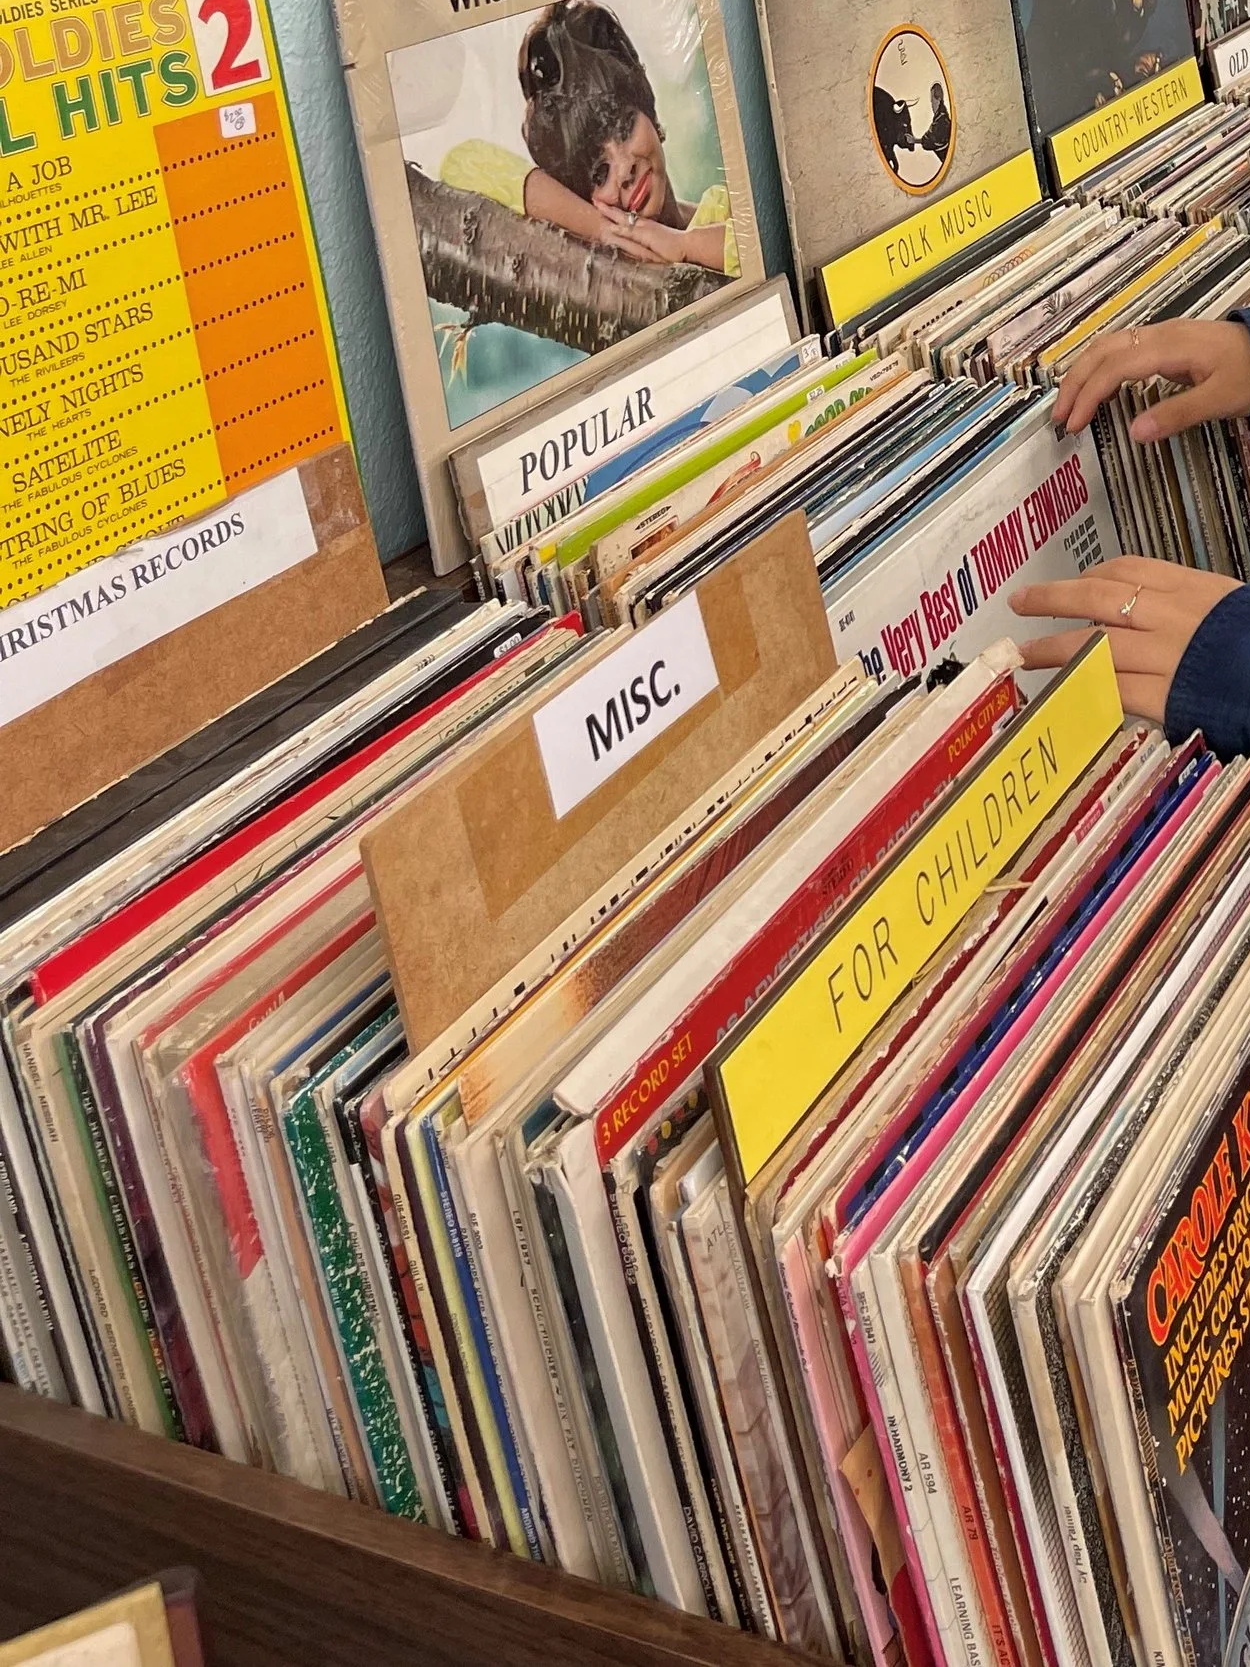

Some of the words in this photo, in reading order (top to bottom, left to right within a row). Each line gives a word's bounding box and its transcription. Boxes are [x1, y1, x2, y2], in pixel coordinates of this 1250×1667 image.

[52, 50, 198, 140] HITS
[1229, 49, 1249, 78] OLD
[1073, 77, 1188, 163] COUNTRY-WESTERN
[6, 172, 23, 192] A
[32, 155, 73, 185] JOB
[0, 217, 63, 254] WITH
[68, 204, 110, 232] MR.
[114, 186, 158, 216] LEE
[886, 224, 934, 278] FOLK
[940, 189, 993, 244] MUSIC
[20, 245, 53, 263] ALLEN
[0, 331, 79, 376] USAND
[84, 302, 154, 343] STARS
[3, 318, 22, 330] LEE
[27, 299, 68, 320] DORSEY
[9, 373, 31, 388] THE
[35, 352, 86, 378] RIVILEERS
[60, 363, 145, 414] NIGHTS
[26, 428, 47, 442] THE
[51, 408, 92, 432] HEARTS
[519, 386, 656, 496] POPULAR
[1, 499, 23, 514] THE
[27, 472, 83, 502] FABULOUS
[86, 446, 139, 475] CYCLONES
[12, 429, 122, 494] SATELITE
[0, 510, 74, 561] TRING
[81, 492, 111, 521] OF
[118, 458, 186, 505] BLUES
[12, 554, 34, 570] THE
[38, 525, 93, 558] FABULOUS
[96, 499, 148, 528] CYCLONES
[640, 507, 667, 528] STEREO
[129, 512, 245, 591] RECORDS
[881, 609, 927, 679] Very
[919, 570, 963, 651] Best
[957, 554, 979, 617] of
[970, 506, 1029, 602] TOMMY
[1023, 453, 1089, 552] EDWARDS
[585, 660, 682, 763] MISC.
[941, 723, 979, 763] POLKA
[971, 701, 999, 730] CITY
[828, 916, 899, 1034] FOR
[914, 727, 1059, 926] CHILDREN
[594, 1124, 616, 1145] 3
[605, 1056, 676, 1133] RECORD
[664, 1029, 701, 1068] SET
[36, 1094, 60, 1143] MESSIAH
[86, 1267, 110, 1319] LEONARD
[102, 1322, 128, 1381] BERNSTEIN
[106, 1193, 138, 1271] CHRISTMAS
[1147, 1131, 1237, 1346] CAROLE
[1164, 1247, 1228, 1391] INCLUDES
[1167, 1334, 1211, 1437] MUSIC
[1175, 1322, 1244, 1478] PICTURES,
[884, 1414, 898, 1428] IN
[885, 1427, 913, 1477] HARMONY
[900, 1476, 914, 1493] 2
[916, 1450, 933, 1473] AR
[921, 1471, 939, 1496] 594
[517, 1506, 537, 1544] AROUND
[681, 1503, 700, 1544] DAVID
[960, 1503, 975, 1526] AR
[966, 1526, 979, 1541] 79
[1060, 1504, 1080, 1543] Palmer
[1069, 1543, 1085, 1568] Hap
[946, 1575, 976, 1641] LEARNING
[990, 1622, 1006, 1647] IT'S
